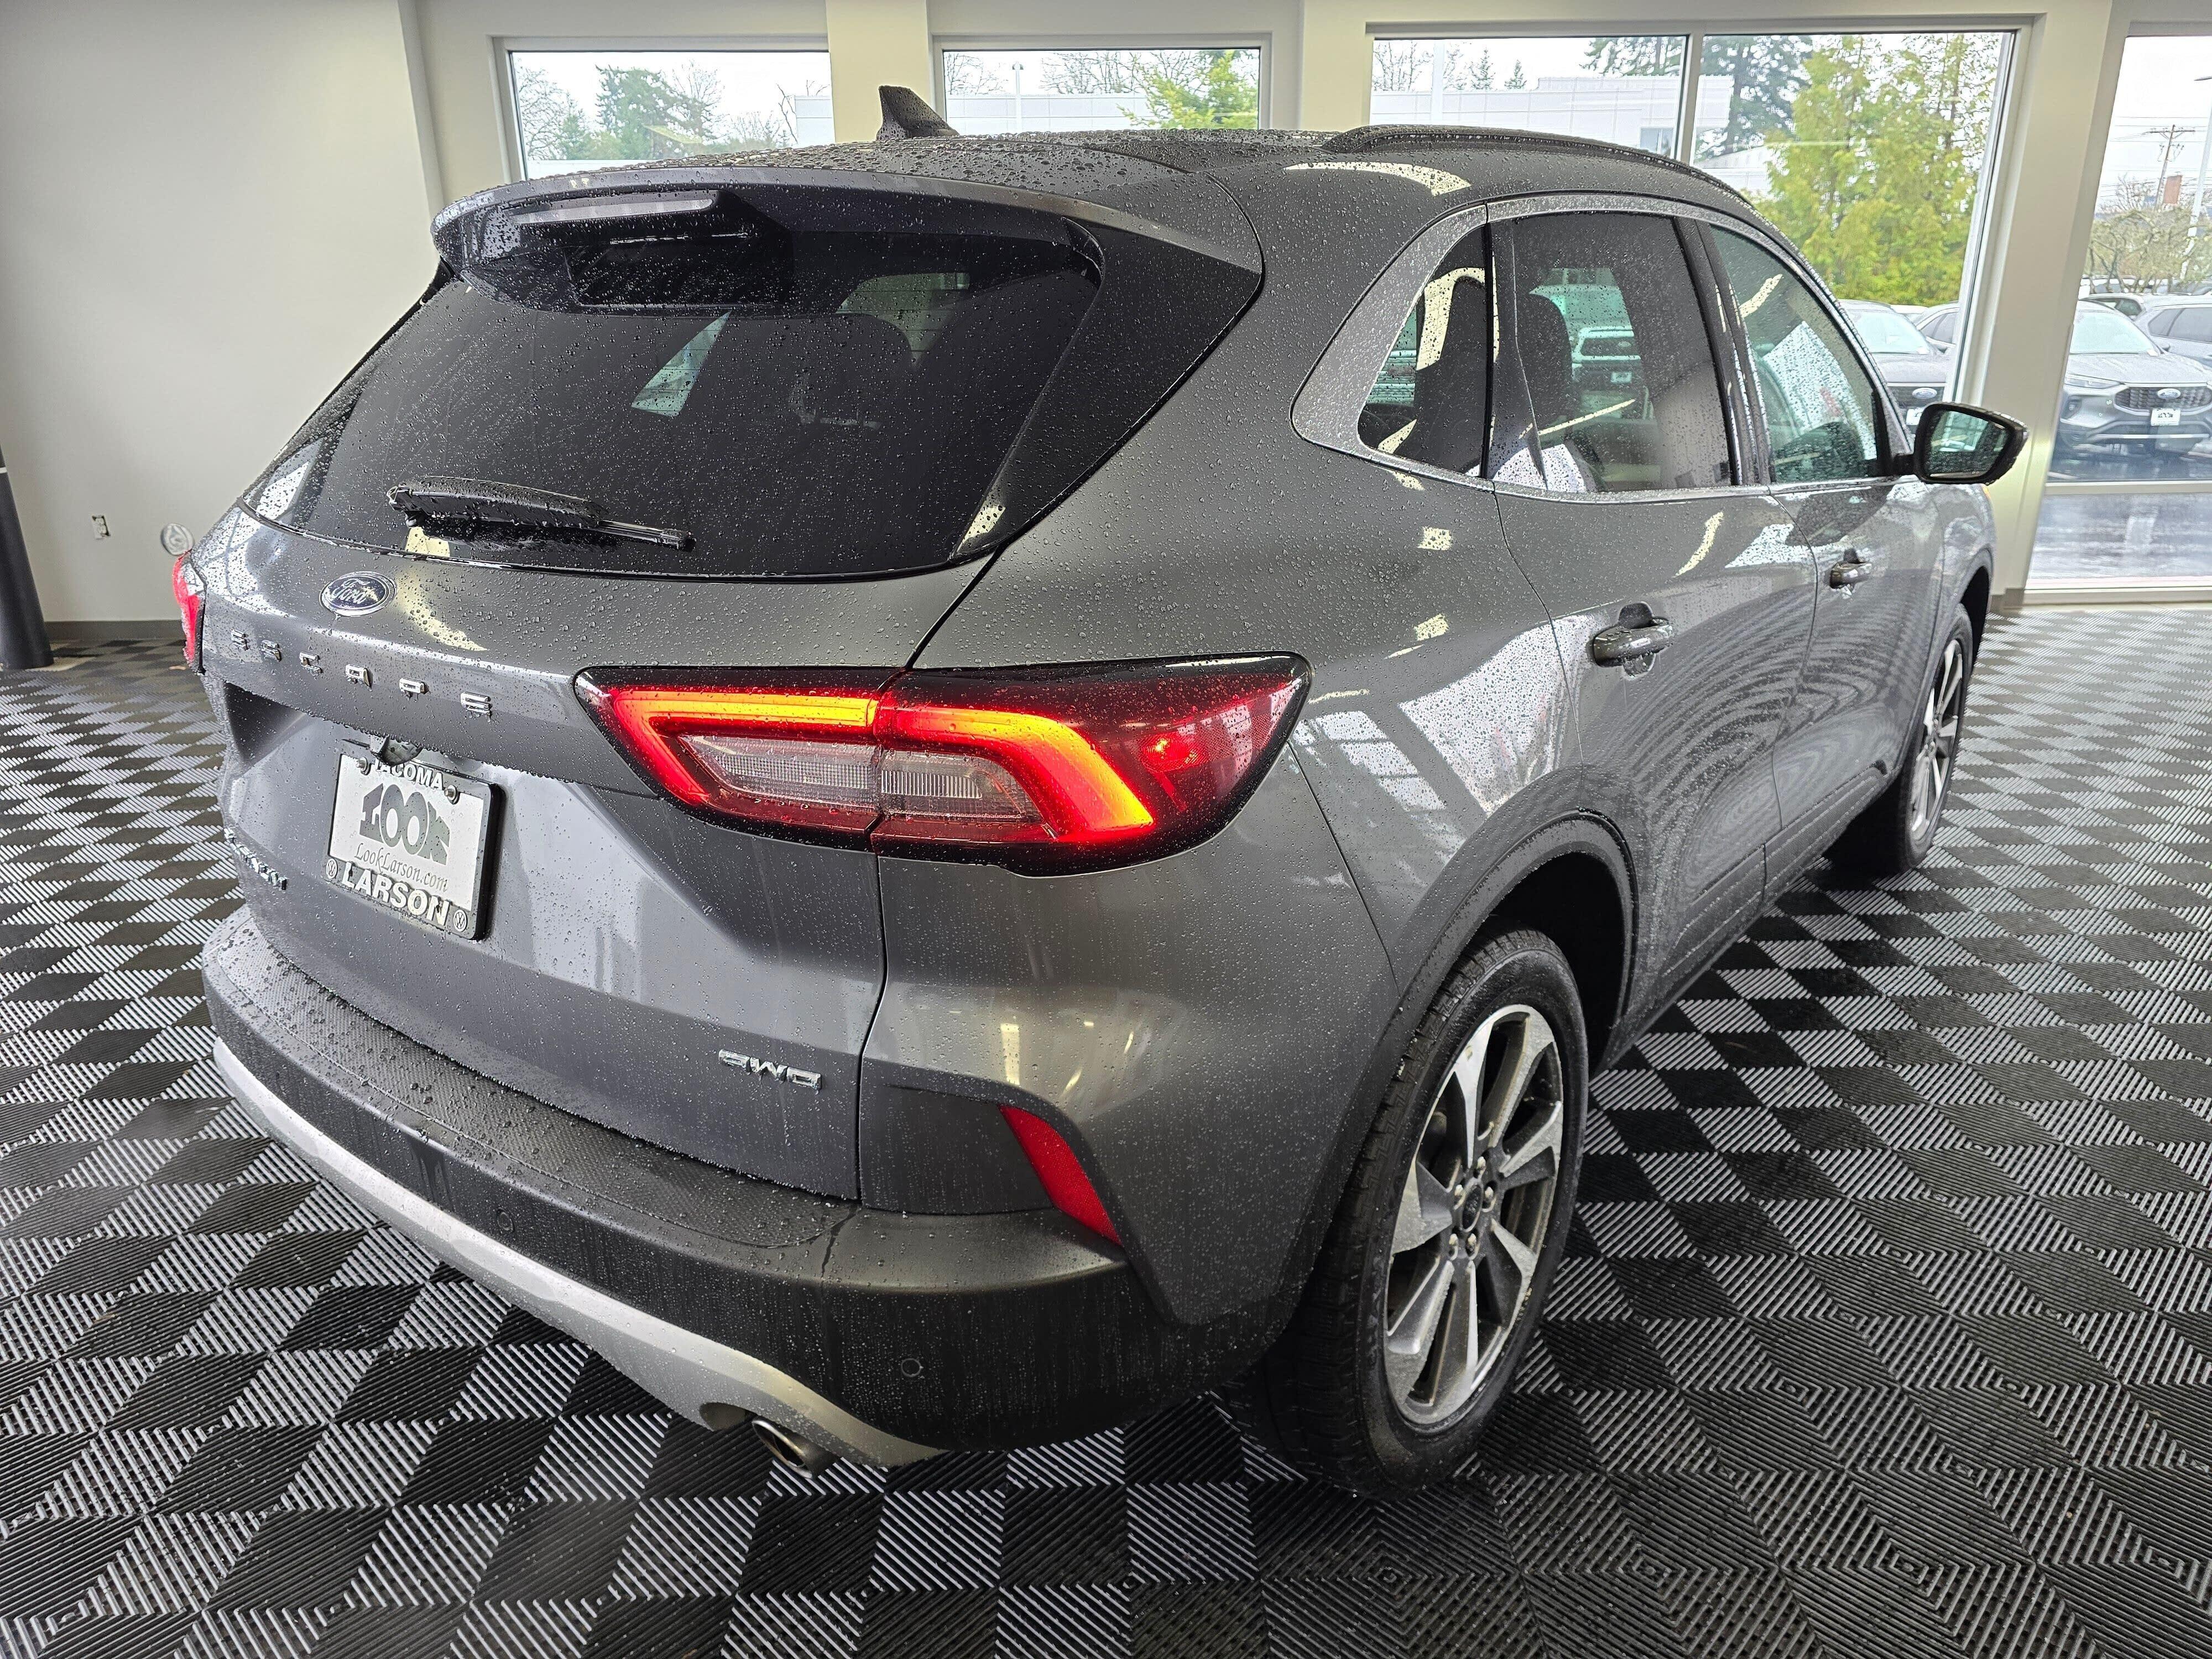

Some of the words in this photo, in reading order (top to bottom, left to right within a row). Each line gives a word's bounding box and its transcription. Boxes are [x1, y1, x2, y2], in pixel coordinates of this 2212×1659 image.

[332, 578, 379, 604] Ford
[231, 629, 491, 714] ESCAPE
[341, 861, 450, 926] LARSON
[354, 842, 448, 893] LookLarson.com
